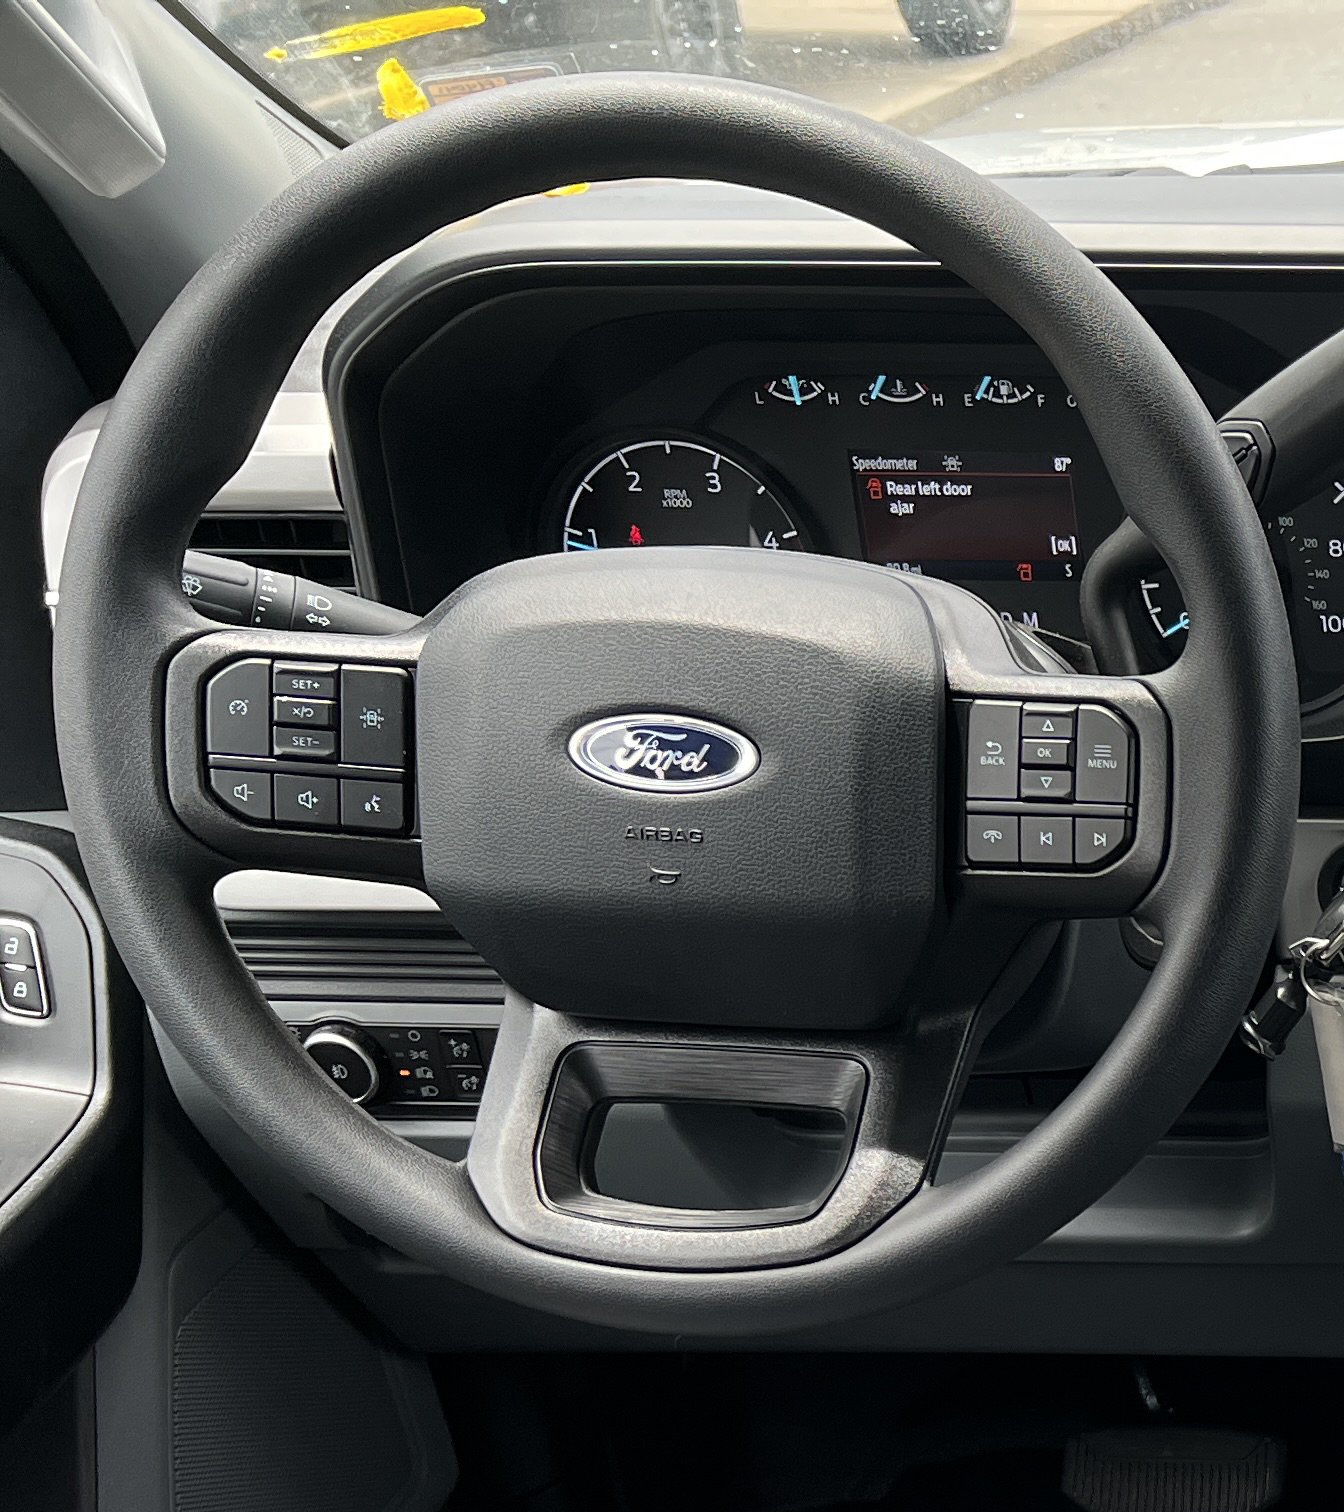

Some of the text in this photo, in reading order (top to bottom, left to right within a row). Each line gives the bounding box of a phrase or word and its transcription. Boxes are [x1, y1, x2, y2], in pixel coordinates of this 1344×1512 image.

[754, 392, 765, 405] L
[828, 392, 840, 406] H
[859, 393, 869, 406] C
[932, 394, 944, 407] H
[964, 393, 974, 407] E
[1037, 394, 1045, 407] F
[852, 456, 918, 471] Speedometer
[626, 471, 643, 492] 2
[705, 472, 722, 493] 3
[663, 488, 688, 499] RPM
[886, 481, 972, 496] Rear left door
[662, 499, 693, 508] x1000
[889, 500, 915, 517] ajar
[1278, 516, 1294, 527] 100
[763, 531, 780, 550] 4
[1304, 538, 1318, 548] 120
[1065, 563, 1073, 577] S
[1315, 569, 1330, 580] 140
[1312, 600, 1327, 611] 160
[1023, 612, 1038, 629] M
[292, 679, 320, 690] SET+
[614, 729, 711, 773] Ford
[1037, 748, 1053, 758] OK
[980, 757, 1006, 766] BACK
[1087, 758, 1118, 769] MENU
[625, 825, 704, 844] AIRBAG
